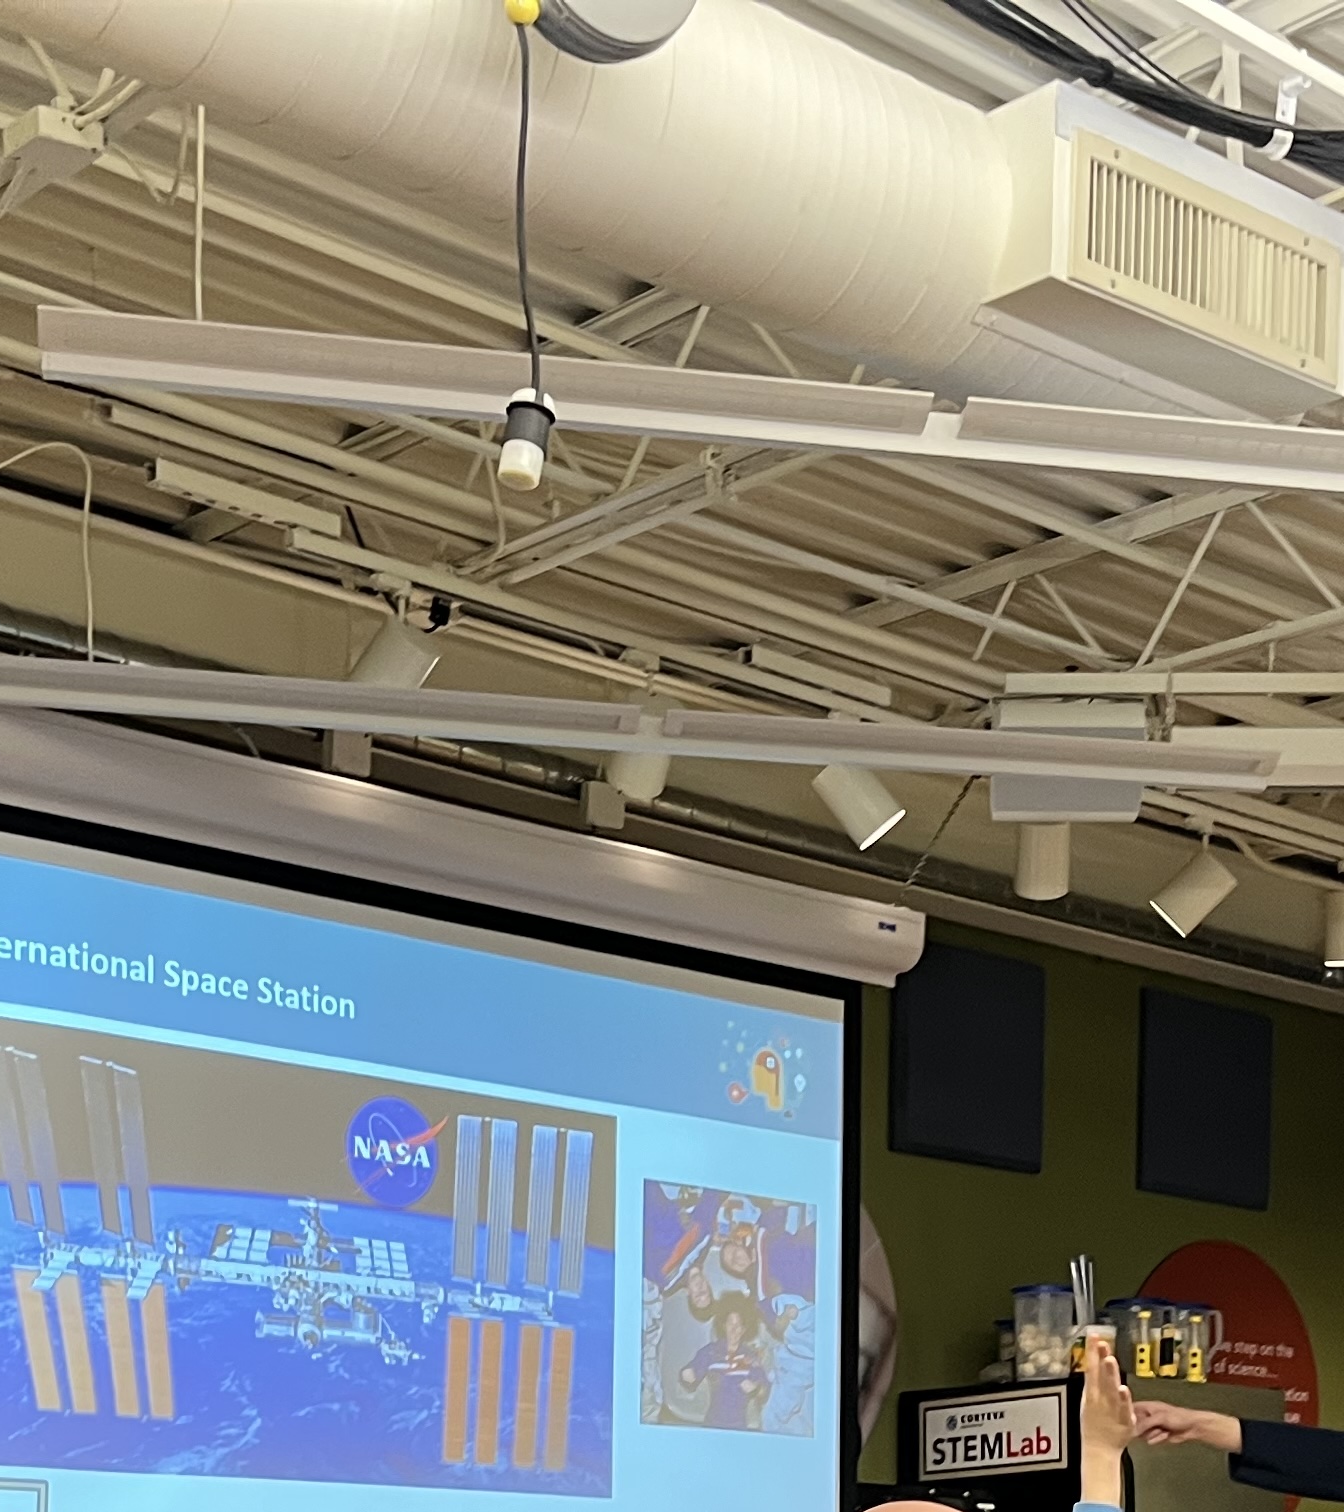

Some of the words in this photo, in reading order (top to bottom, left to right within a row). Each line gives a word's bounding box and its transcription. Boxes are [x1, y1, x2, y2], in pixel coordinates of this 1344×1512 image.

[163, 960, 249, 1000] Space
[257, 977, 356, 1019] Station
[354, 1135, 431, 1168] NASA
[960, 1411, 1005, 1424] CORTEVA
[932, 1425, 1052, 1466] STEMLab
